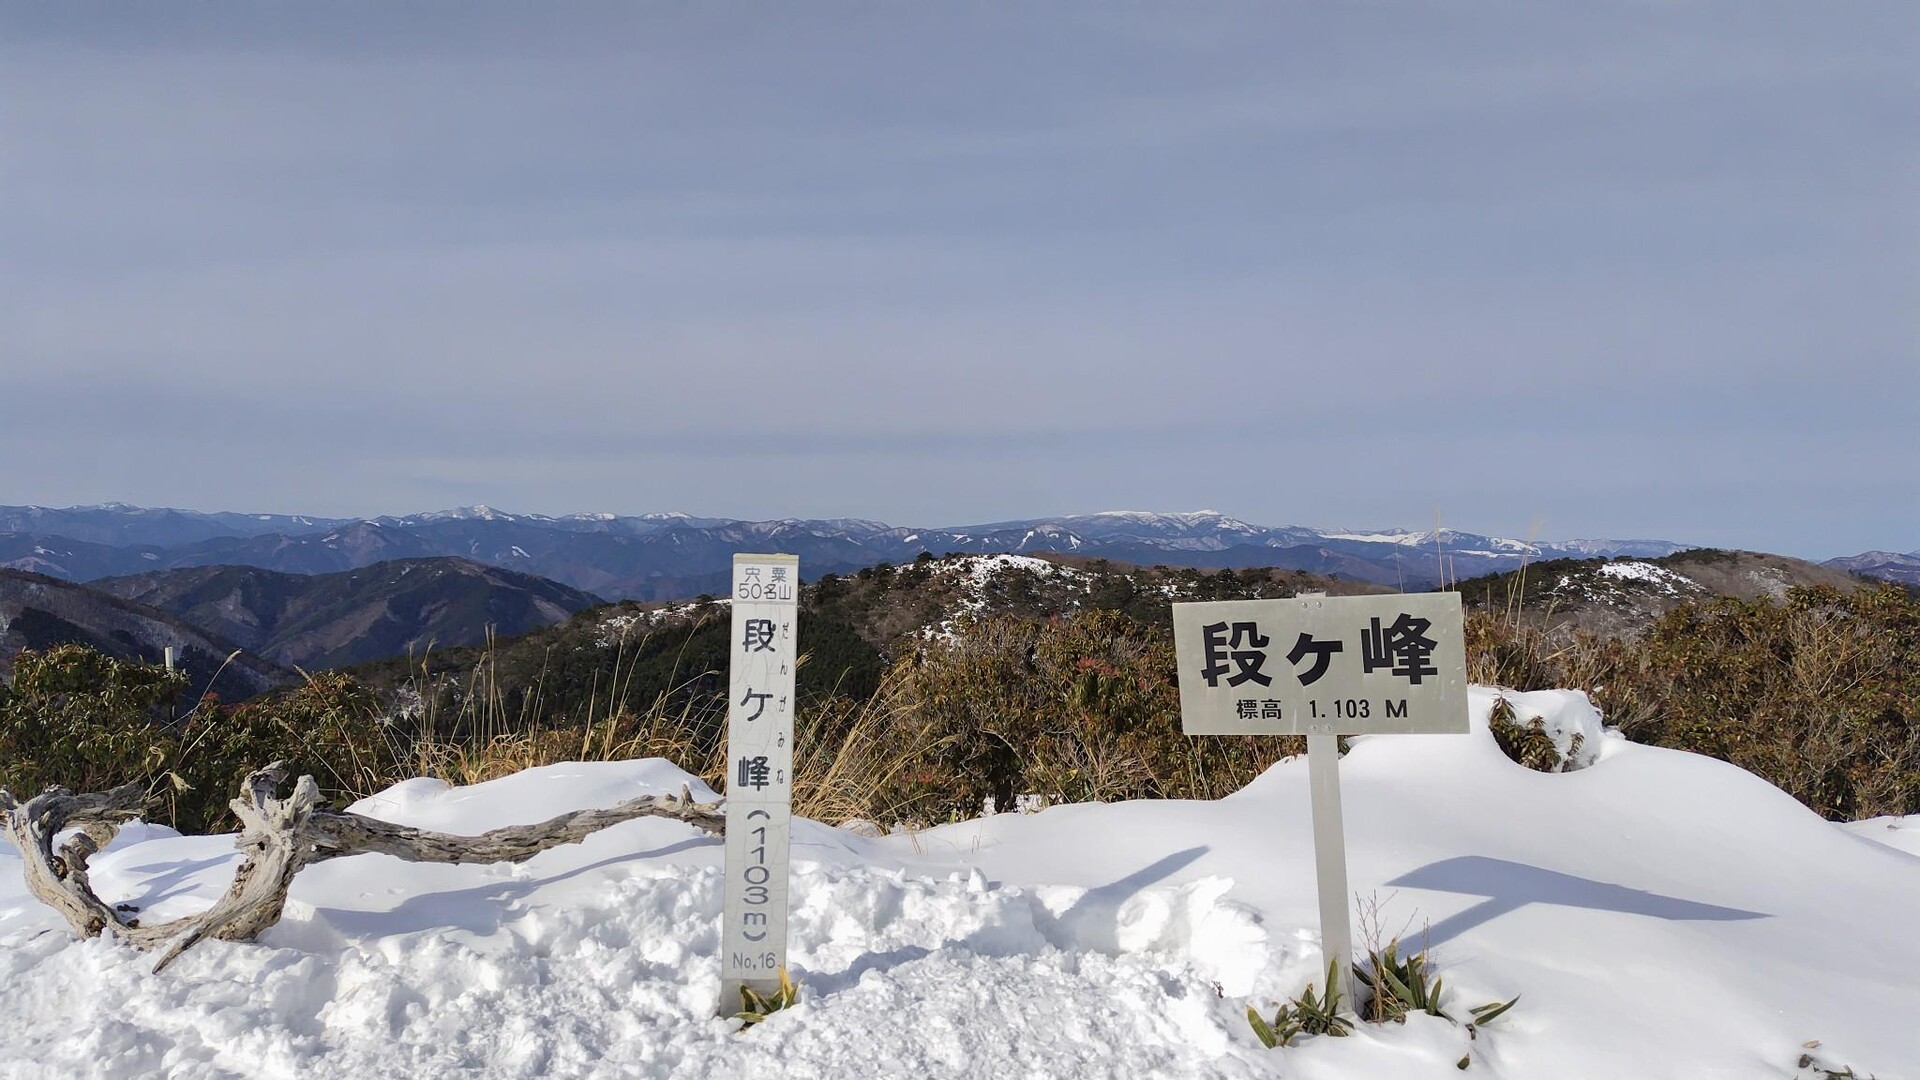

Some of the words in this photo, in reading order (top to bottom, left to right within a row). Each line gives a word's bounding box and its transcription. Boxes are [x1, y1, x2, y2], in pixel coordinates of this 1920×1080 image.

[738, 583, 792, 600] 50名山
[1236, 699, 1282, 721] 標高
[1309, 699, 1370, 720] 1.103
[1386, 699, 1408, 719] M
